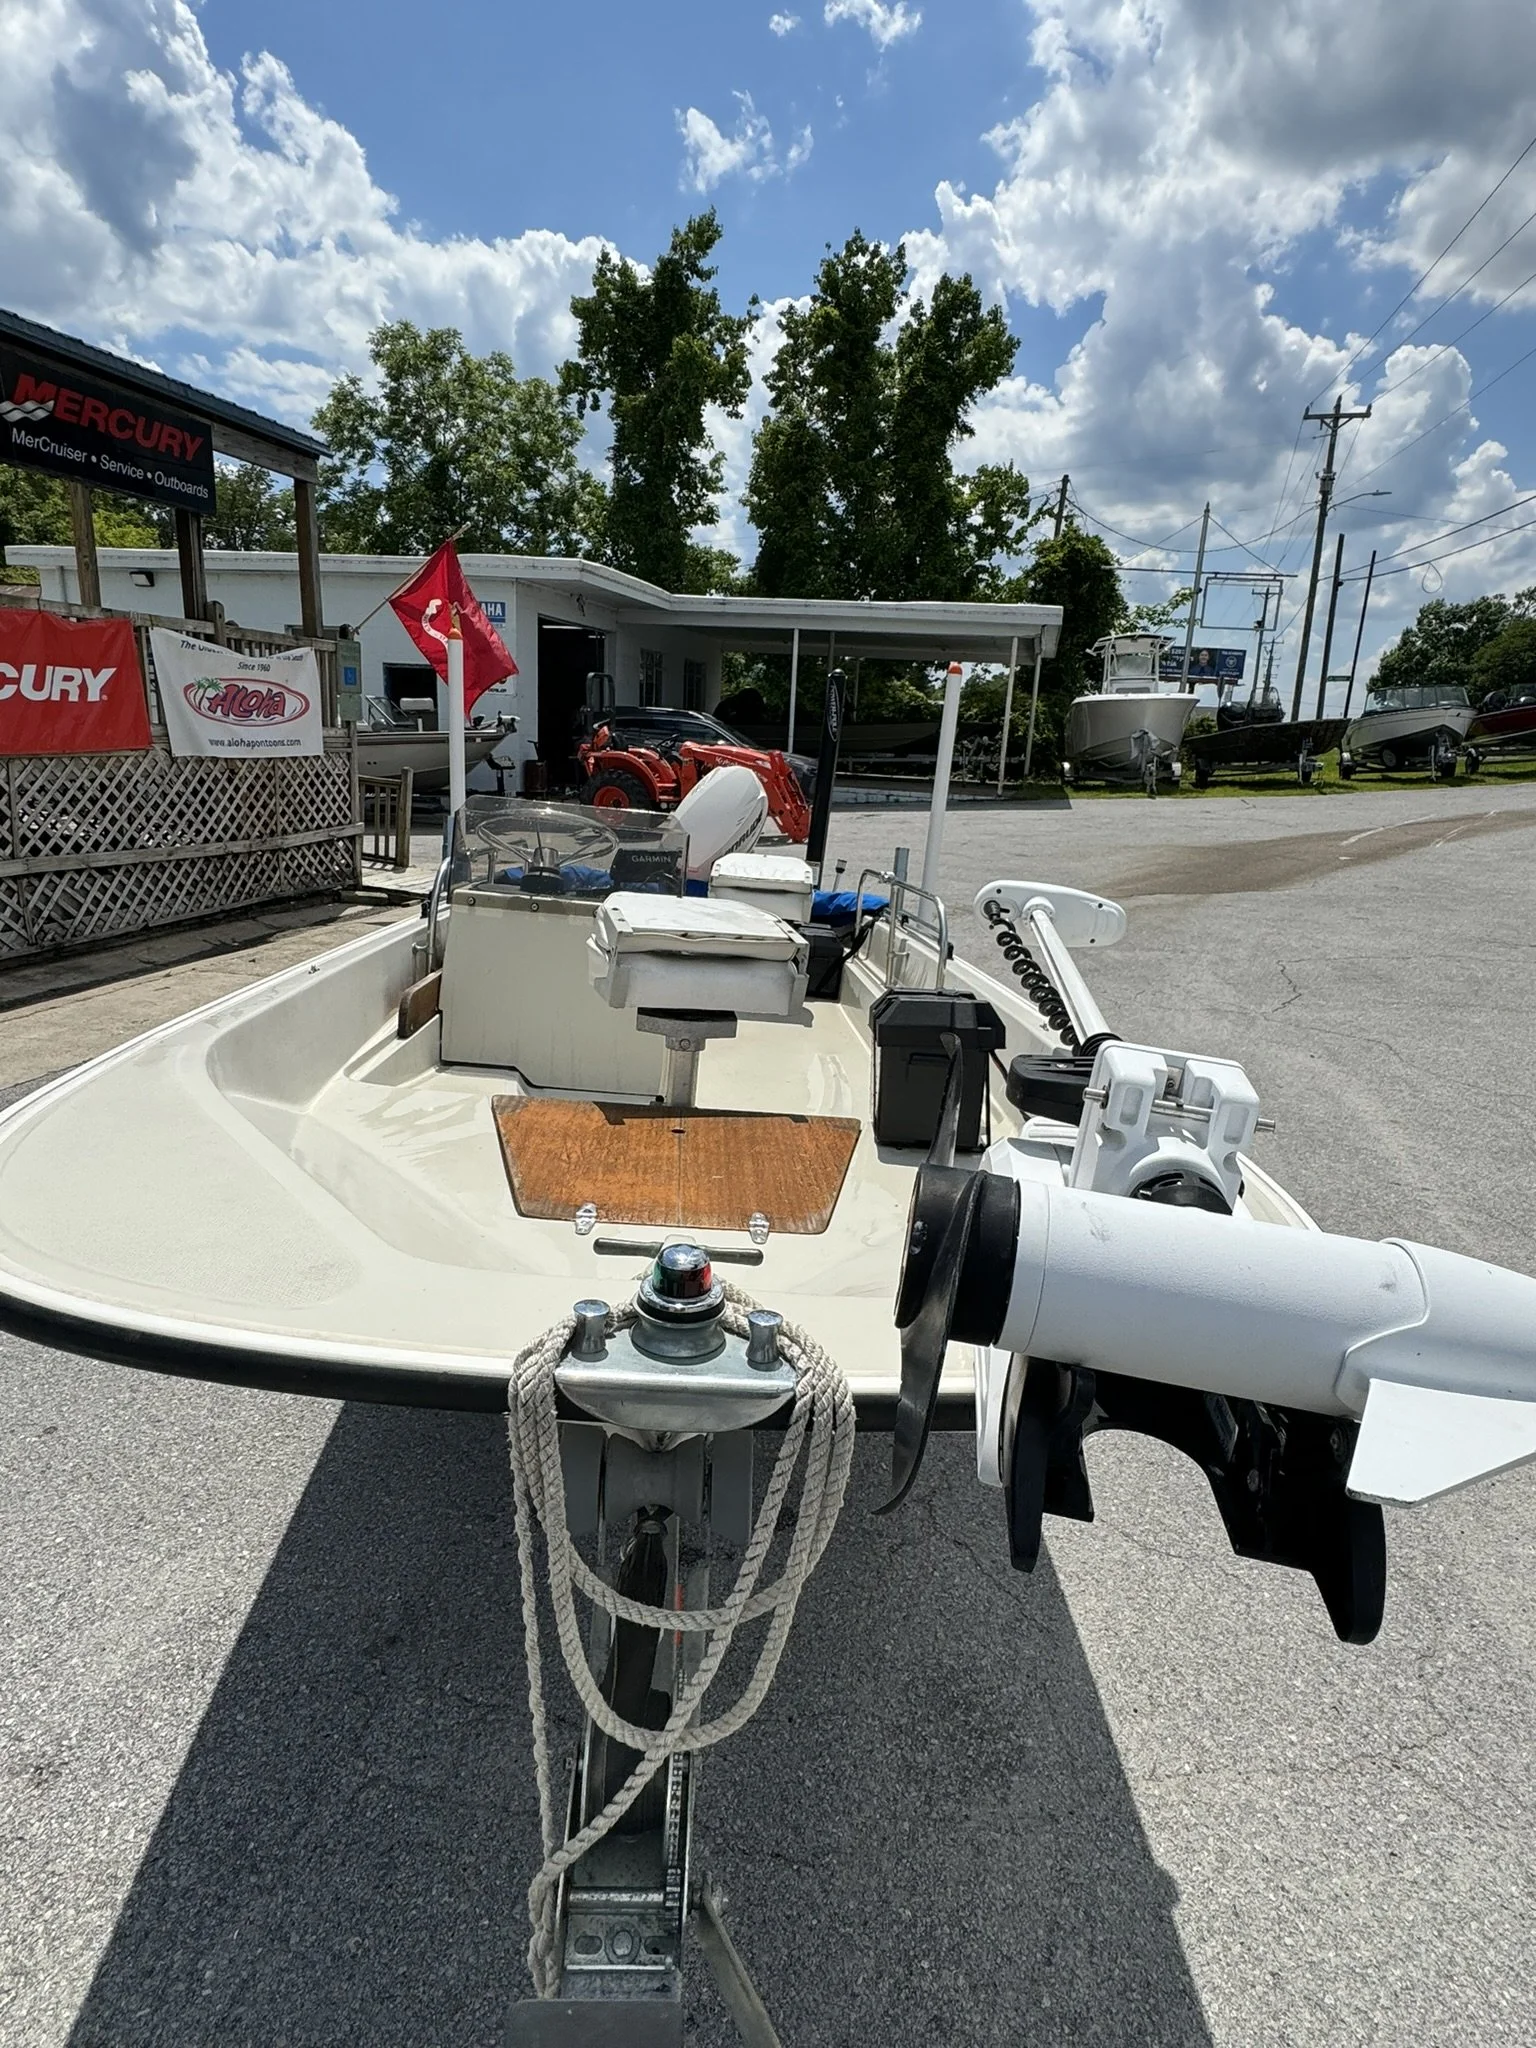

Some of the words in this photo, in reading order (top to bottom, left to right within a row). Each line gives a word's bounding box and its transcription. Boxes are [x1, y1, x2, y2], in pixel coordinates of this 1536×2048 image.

[14, 373, 204, 461] MERCURY
[12, 427, 87, 463] MerCruiser
[100, 455, 144, 480] Service
[154, 471, 209, 499] Outboards
[481, 602, 503, 616] AHA
[180, 640, 196, 650] The
[237, 662, 256, 671] Since
[257, 663, 271, 673] 1960
[0, 662, 118, 702] CURY
[208, 738, 302, 750] www.alohapontoons.com
[631, 855, 672, 863] GARMIN
